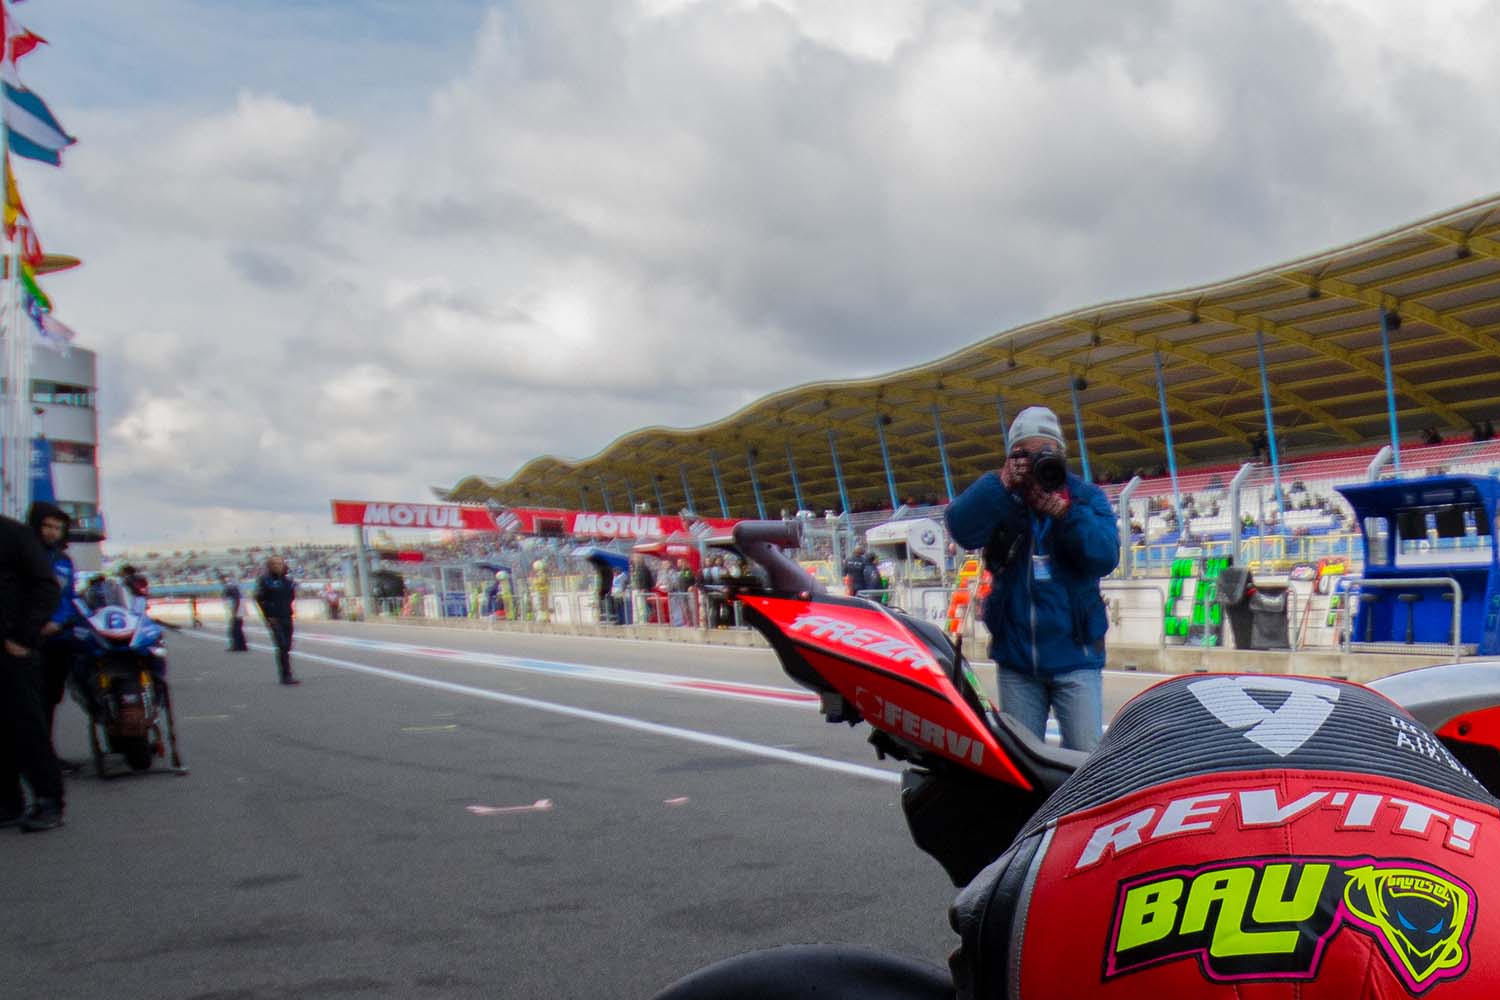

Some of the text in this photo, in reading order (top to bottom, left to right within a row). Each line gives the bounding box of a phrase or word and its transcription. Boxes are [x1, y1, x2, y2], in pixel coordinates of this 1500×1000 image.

[363, 503, 464, 528] MOTUL
[572, 513, 661, 537] MOTUL
[884, 702, 985, 766] FERVI
